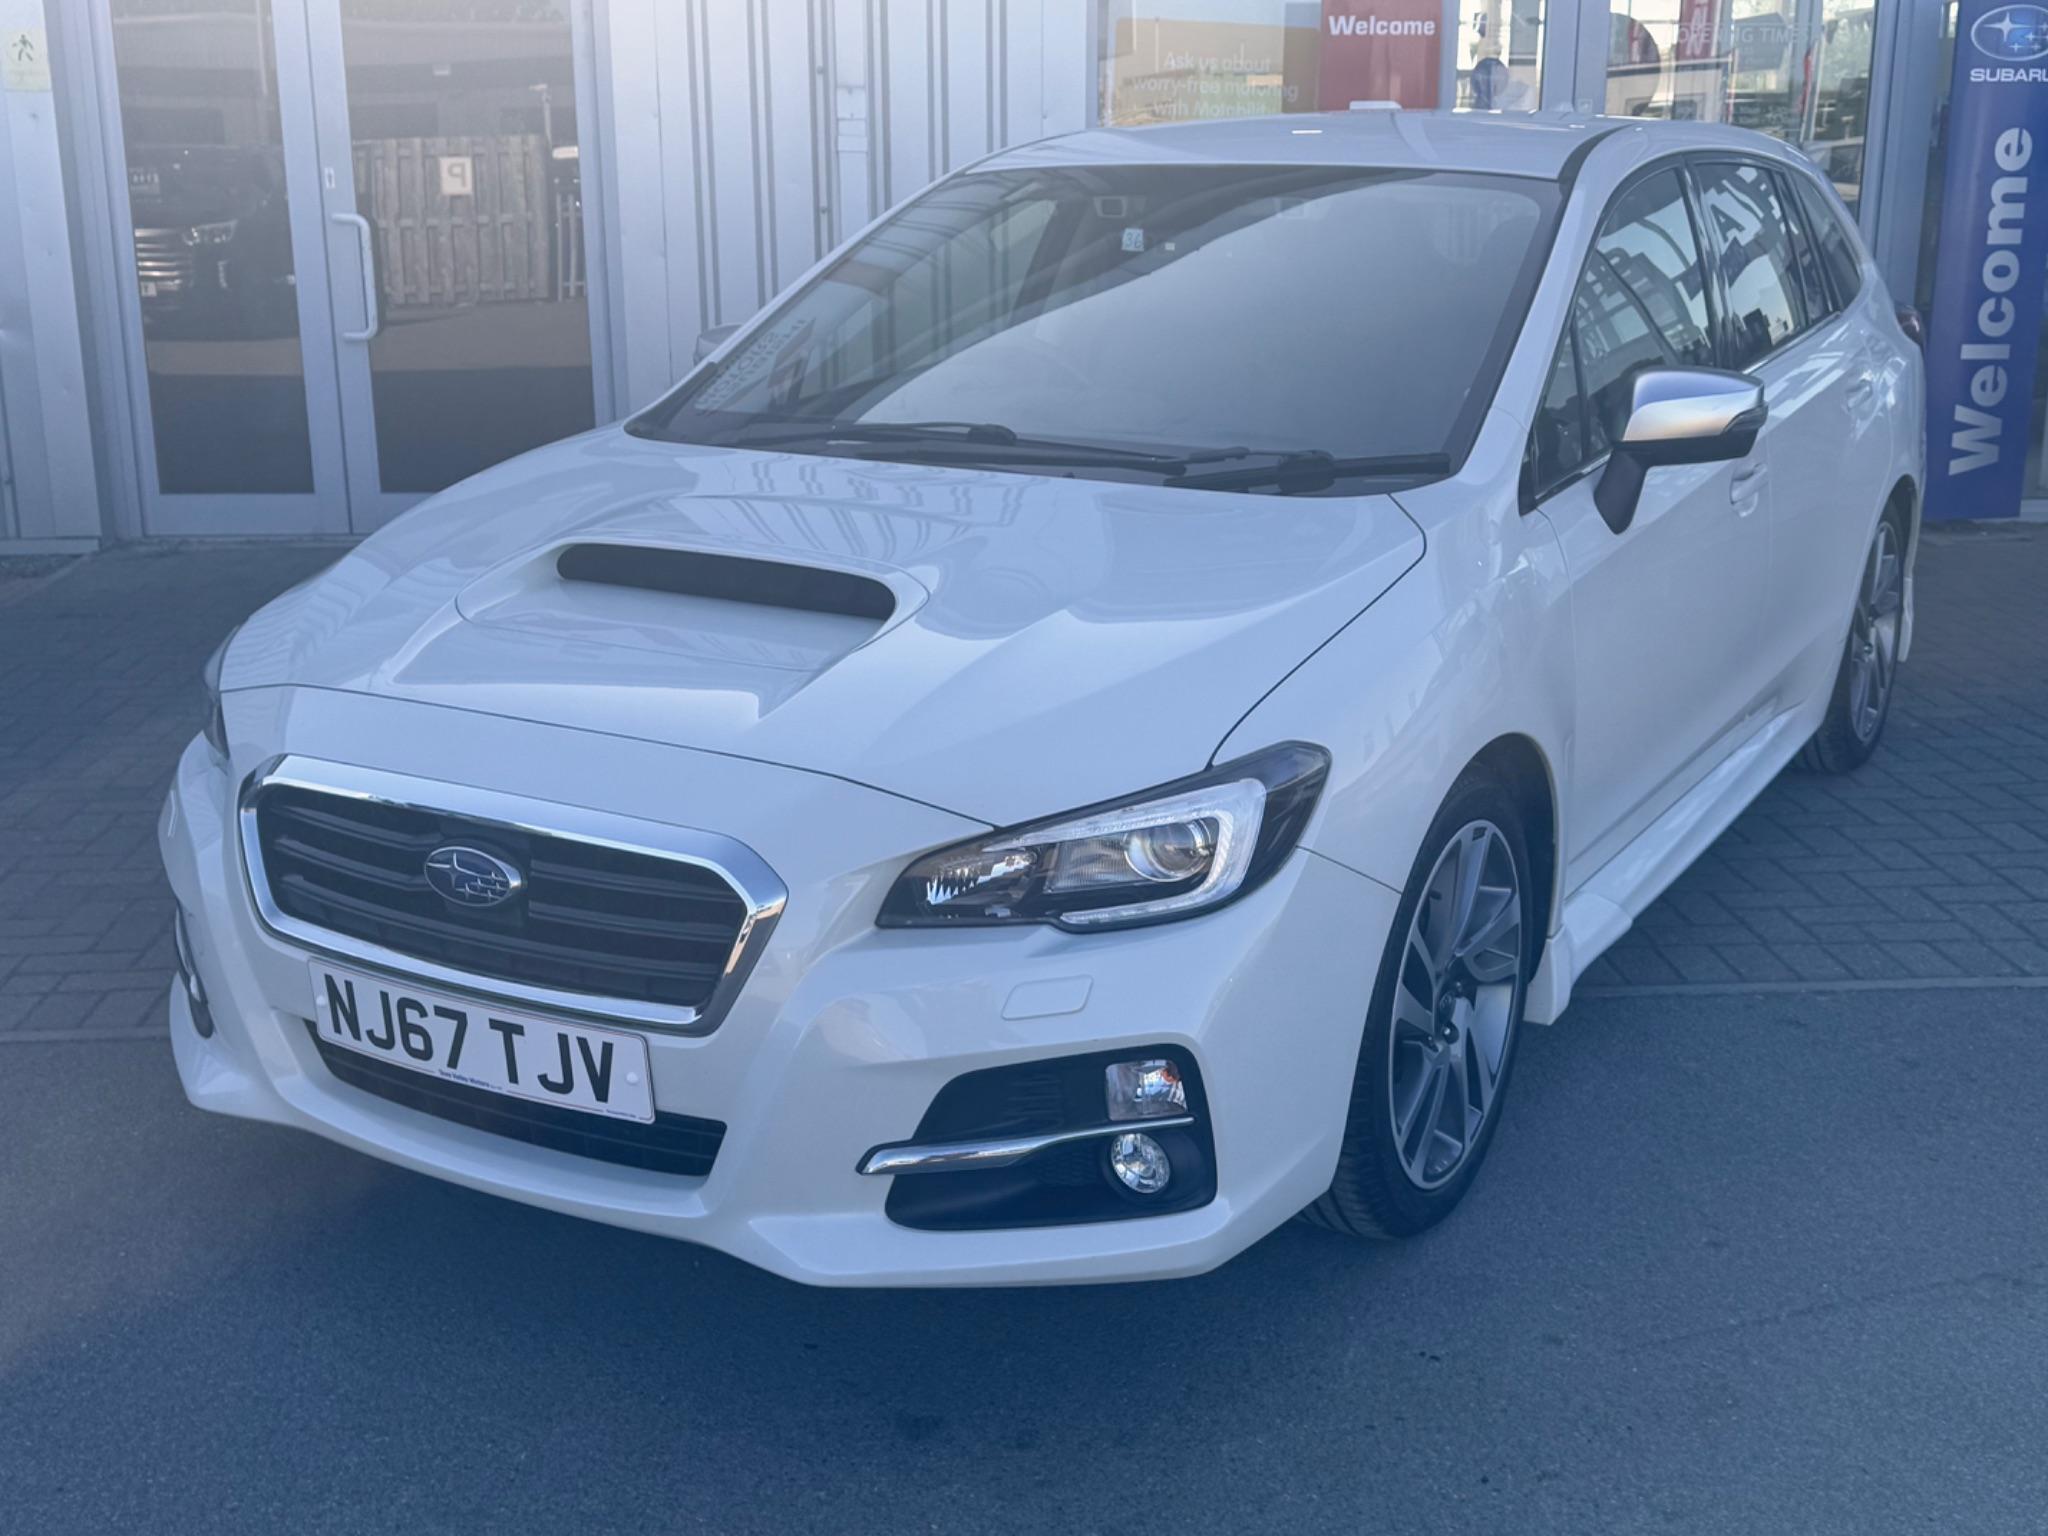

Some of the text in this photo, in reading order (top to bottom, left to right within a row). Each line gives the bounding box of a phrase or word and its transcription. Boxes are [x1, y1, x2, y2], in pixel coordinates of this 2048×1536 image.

[1329, 15, 1435, 36] Welcome
[1679, 27, 1808, 42] OPENING TIMES
[1164, 52, 1271, 73] Ask us about
[1133, 76, 1299, 101] worry-free motoring
[1154, 98, 1190, 117] with
[1949, 126, 2032, 476] Welcome
[324, 973, 614, 1103] NJ67 TJV
